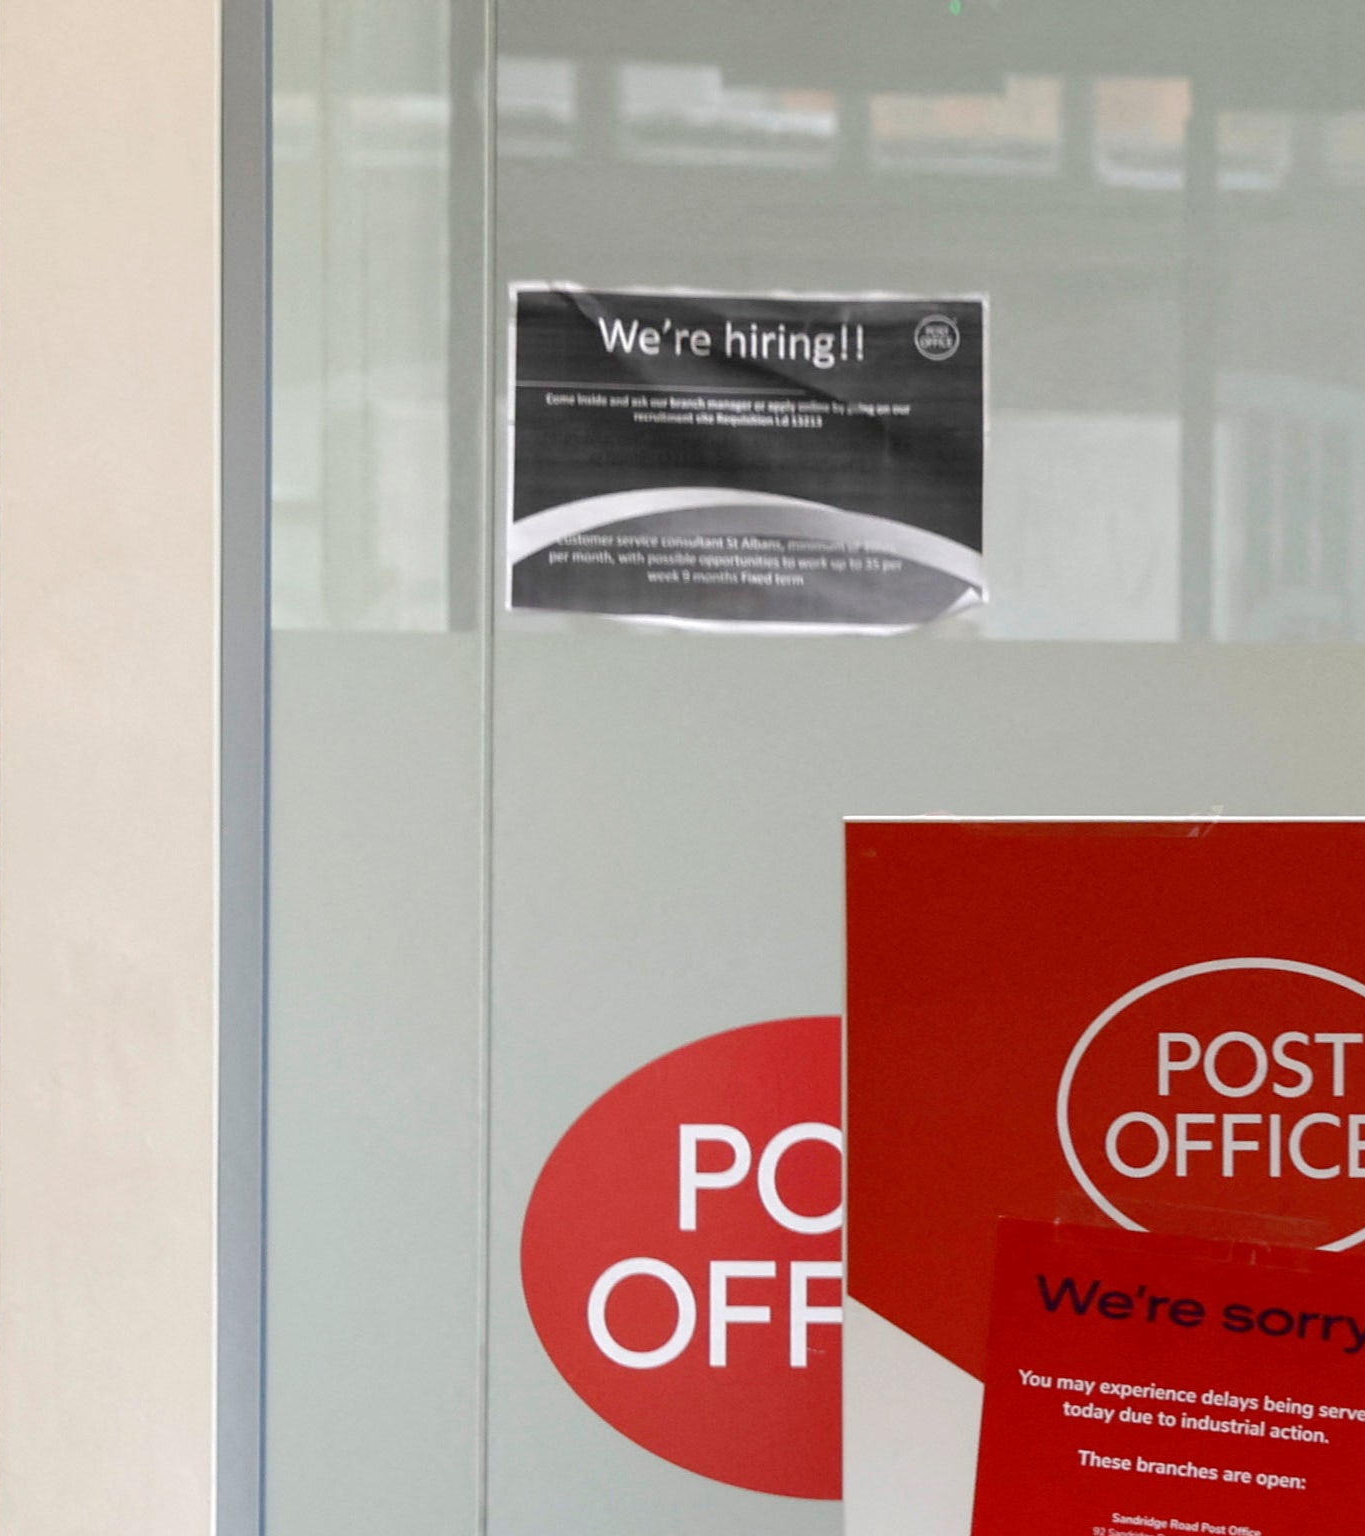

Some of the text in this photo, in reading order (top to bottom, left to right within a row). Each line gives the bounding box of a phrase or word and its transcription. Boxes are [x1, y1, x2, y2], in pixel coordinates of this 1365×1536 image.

[598, 316, 864, 368] We're hiring!!
[670, 395, 705, 410] branch
[548, 551, 570, 565] per
[618, 551, 645, 564] with
[647, 551, 696, 566] possible
[698, 553, 780, 568] opportunities
[782, 556, 796, 568] to
[798, 556, 827, 569] work
[830, 560, 846, 573] up
[849, 557, 862, 570] to
[615, 535, 658, 548] service
[661, 535, 723, 549] consultant
[726, 536, 738, 548] St
[647, 570, 679, 583] week
[693, 570, 738, 584] months
[775, 573, 804, 586] term
[1157, 1031, 1364, 1099] POST
[586, 1256, 843, 1369] OFF
[1036, 1273, 1206, 1329] We're
[1018, 1369, 1052, 1388] You
[1057, 1377, 1095, 1396] may
[1099, 1382, 1197, 1403] experience
[1201, 1389, 1259, 1412] delays
[1263, 1395, 1314, 1419] being
[1062, 1401, 1329, 1444] today due to industrial action.
[1078, 1449, 1307, 1490] These branches are open:
[1092, 1526, 1106, 1536] 92
[1111, 1512, 1168, 1530] Sandridge
[1170, 1518, 1199, 1532] Road
[1201, 1522, 1226, 1535] Post
